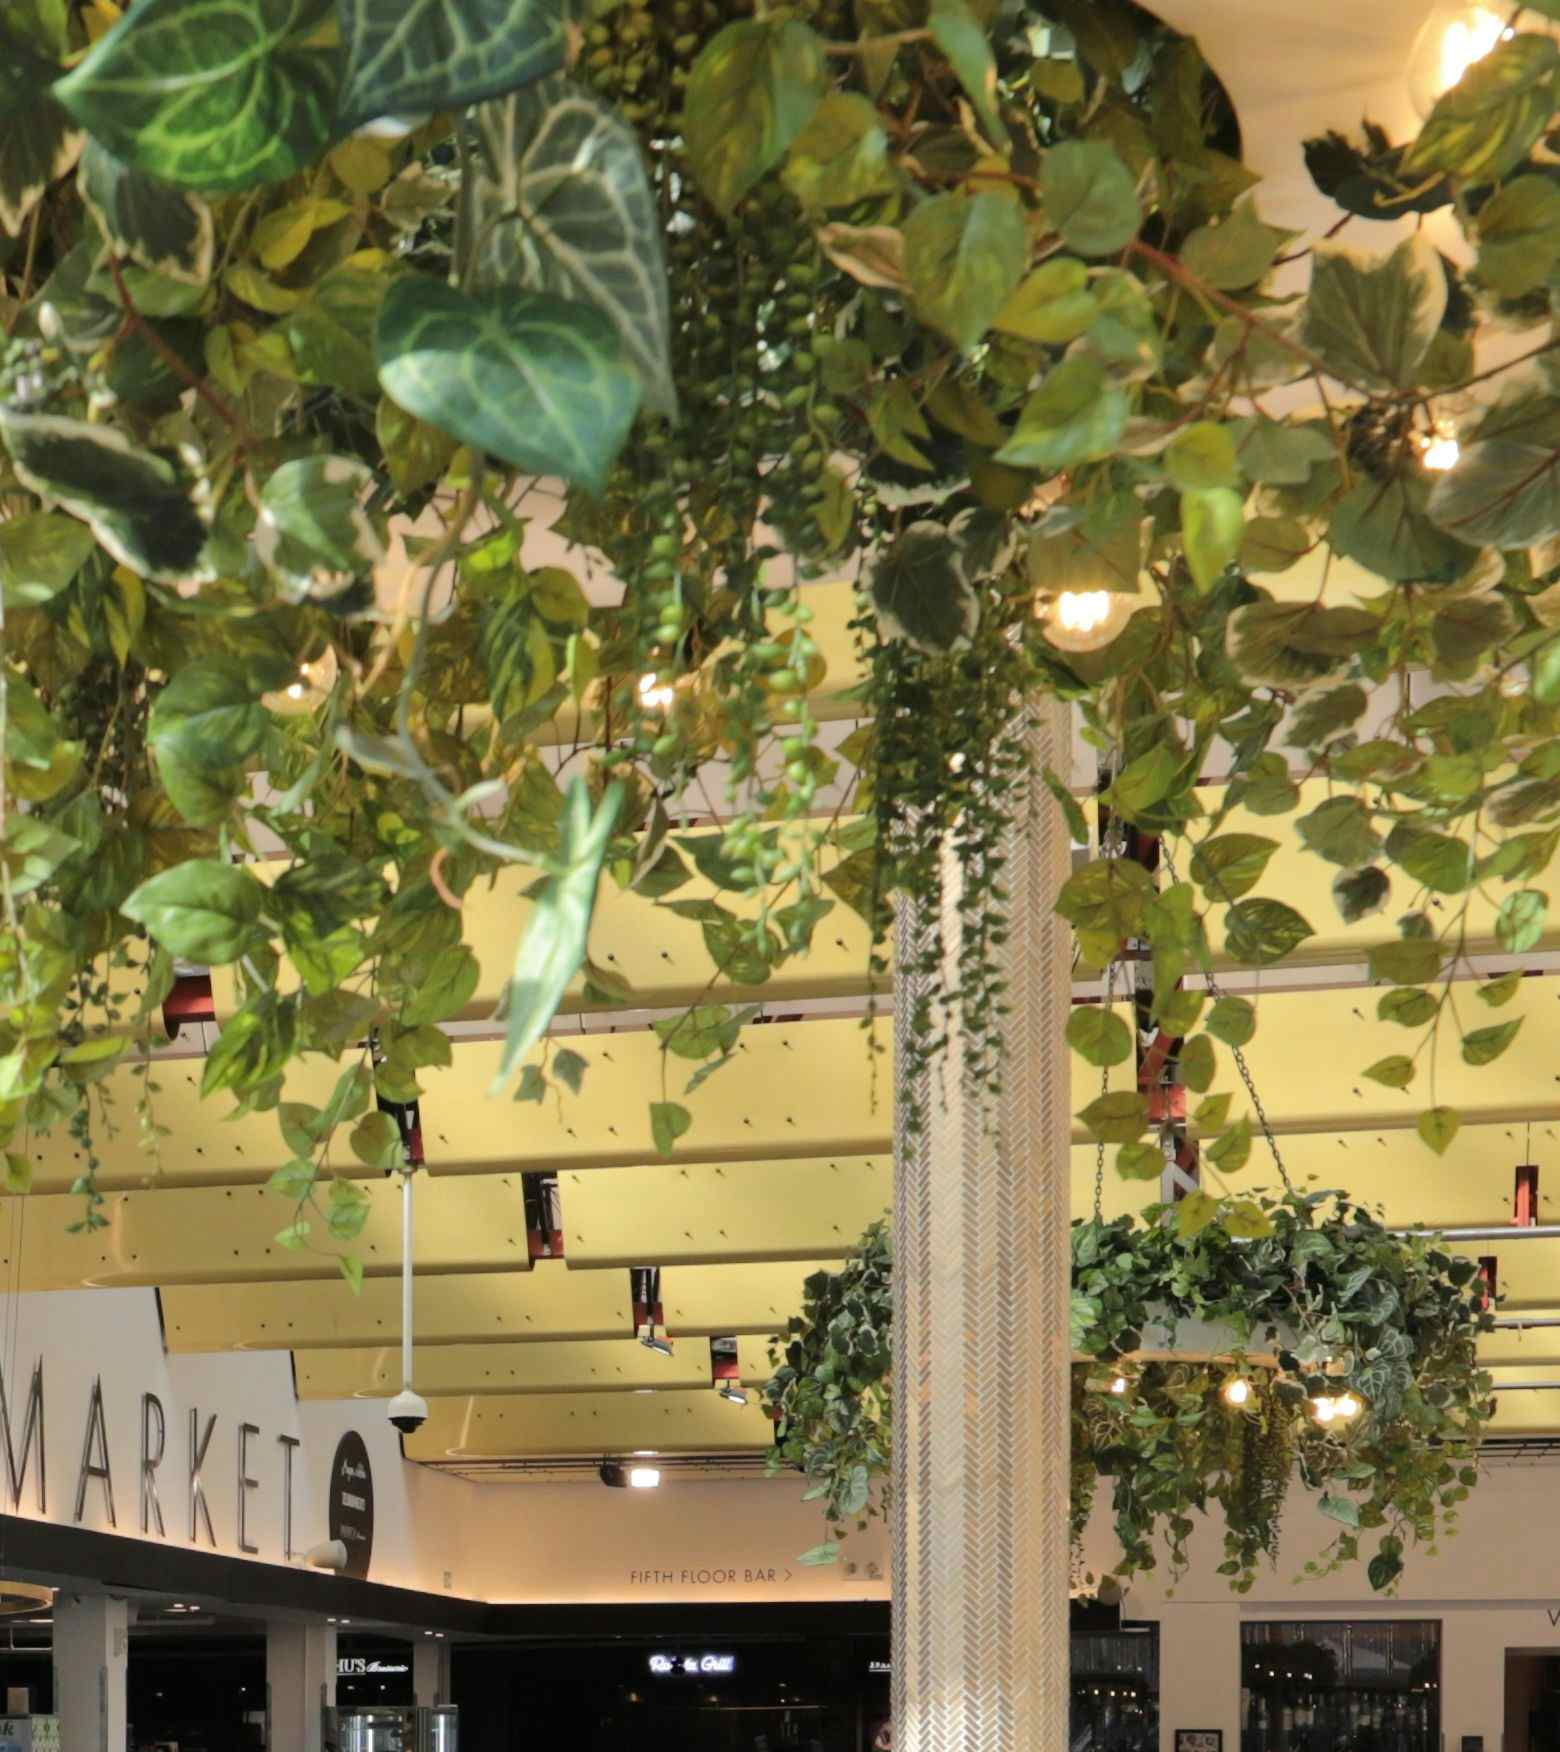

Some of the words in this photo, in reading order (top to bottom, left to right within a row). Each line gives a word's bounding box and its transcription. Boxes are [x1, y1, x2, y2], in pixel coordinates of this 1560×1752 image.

[630, 1570, 674, 1585] FIFTH
[681, 1568, 737, 1585] FLOOR
[744, 1568, 777, 1583] BAR
